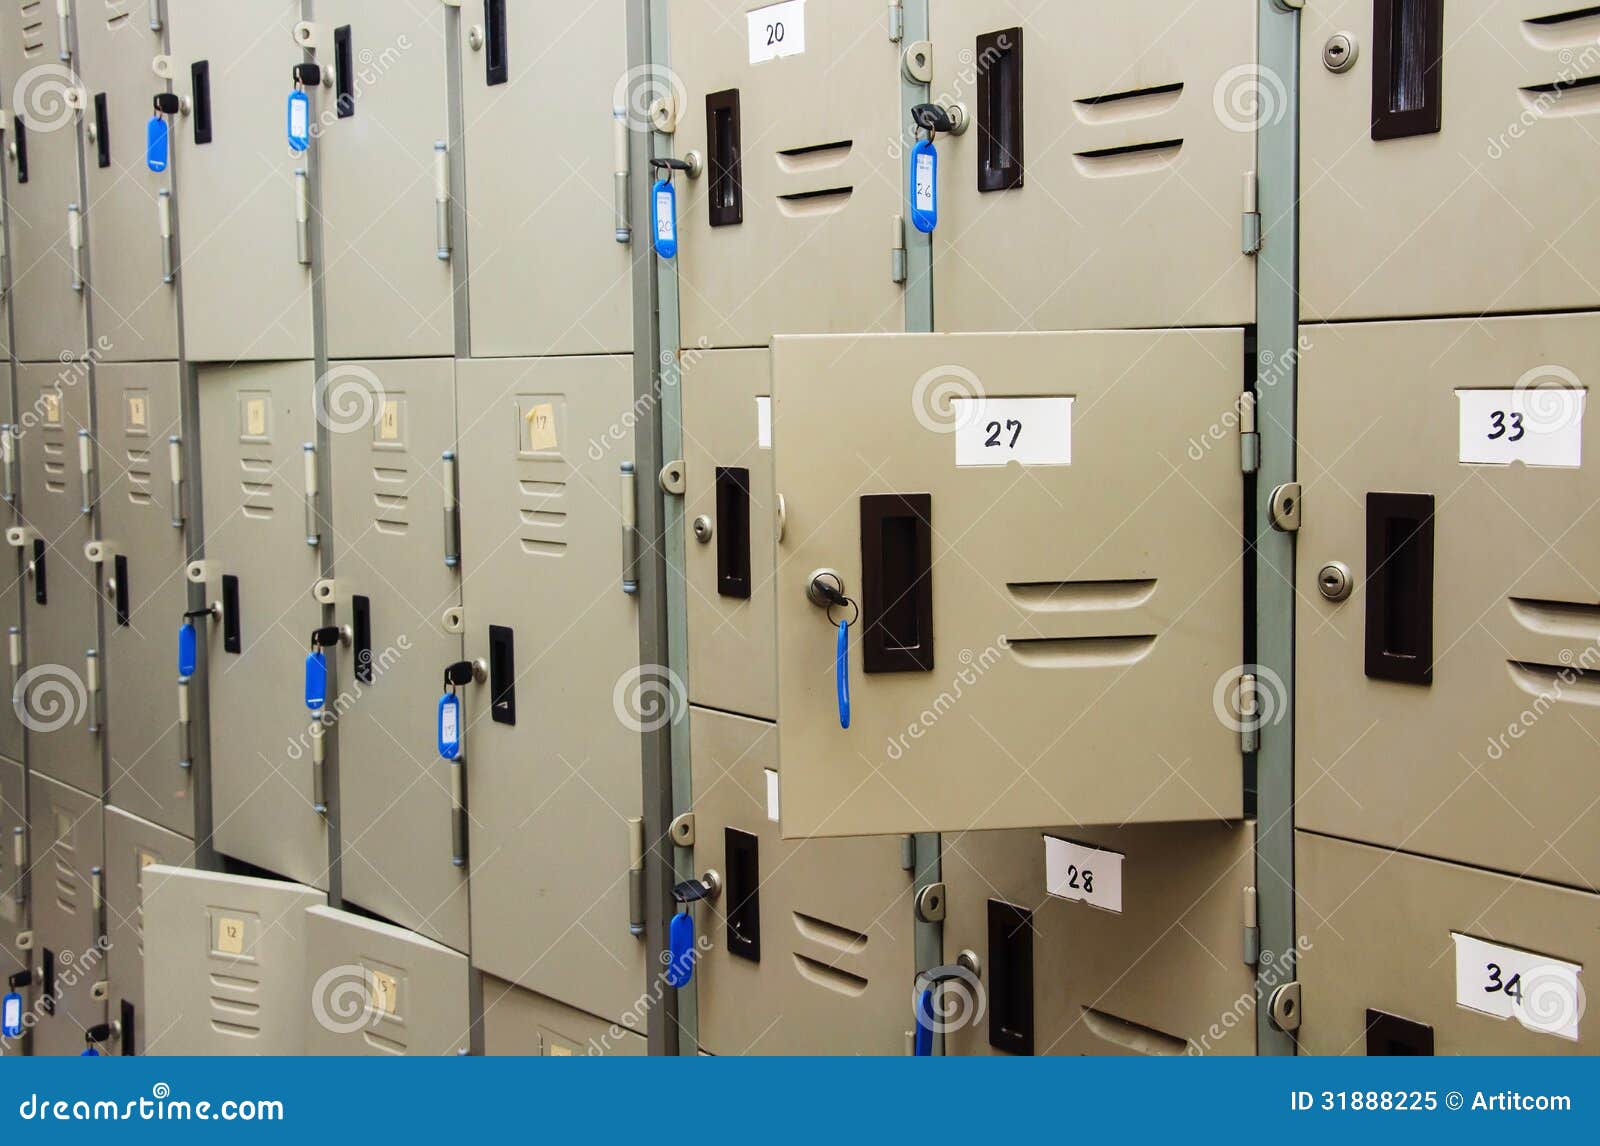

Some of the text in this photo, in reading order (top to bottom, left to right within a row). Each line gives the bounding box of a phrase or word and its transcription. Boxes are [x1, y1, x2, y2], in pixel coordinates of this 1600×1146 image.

[766, 22, 785, 46] 20
[917, 182, 932, 198] 26
[658, 219, 672, 233] 20
[536, 415, 547, 430] 17
[984, 418, 1022, 449] 27
[1487, 410, 1525, 442] 33
[1067, 864, 1093, 893] 28
[227, 925, 237, 938] 12
[1484, 962, 1523, 1006] 34
